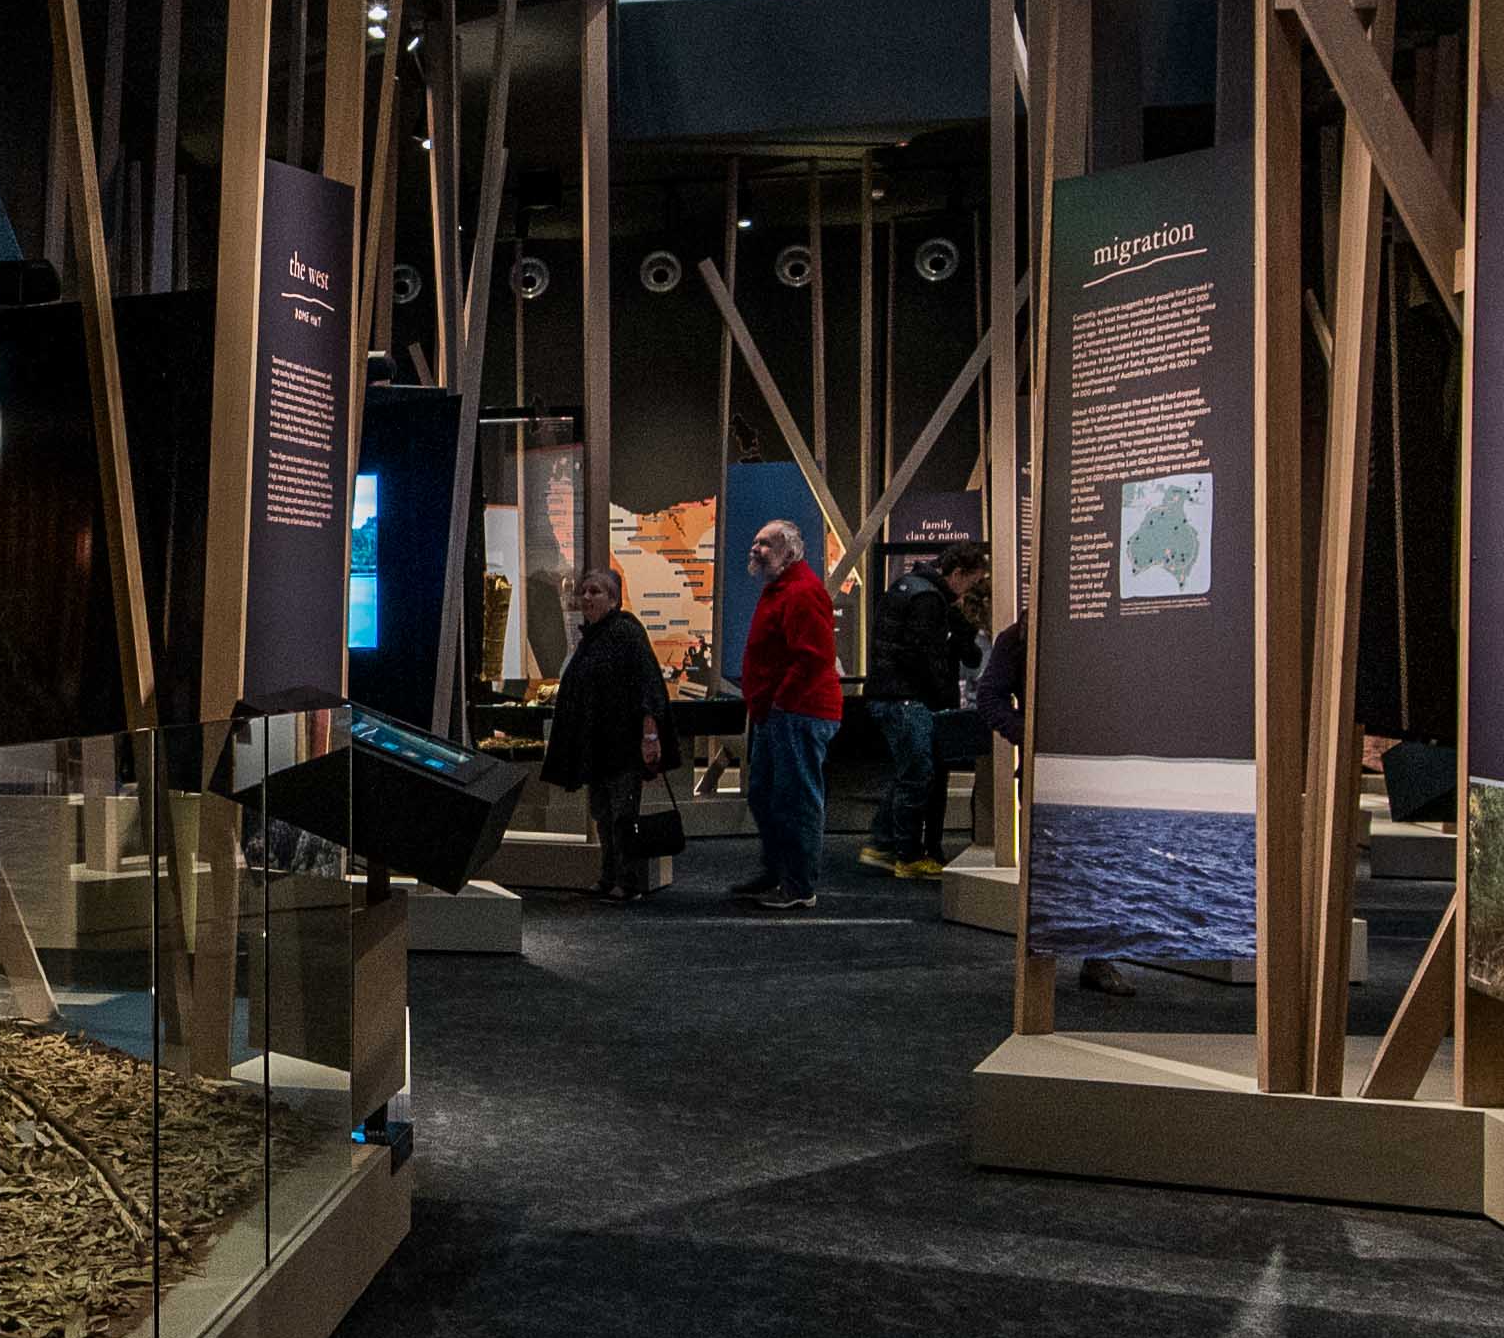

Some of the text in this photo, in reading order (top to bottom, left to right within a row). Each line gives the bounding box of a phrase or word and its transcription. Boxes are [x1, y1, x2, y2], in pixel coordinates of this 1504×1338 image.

[1093, 222, 1195, 267] migration
[289, 250, 329, 291] the west
[905, 531, 969, 541] clan & nation
[922, 519, 952, 531] family
